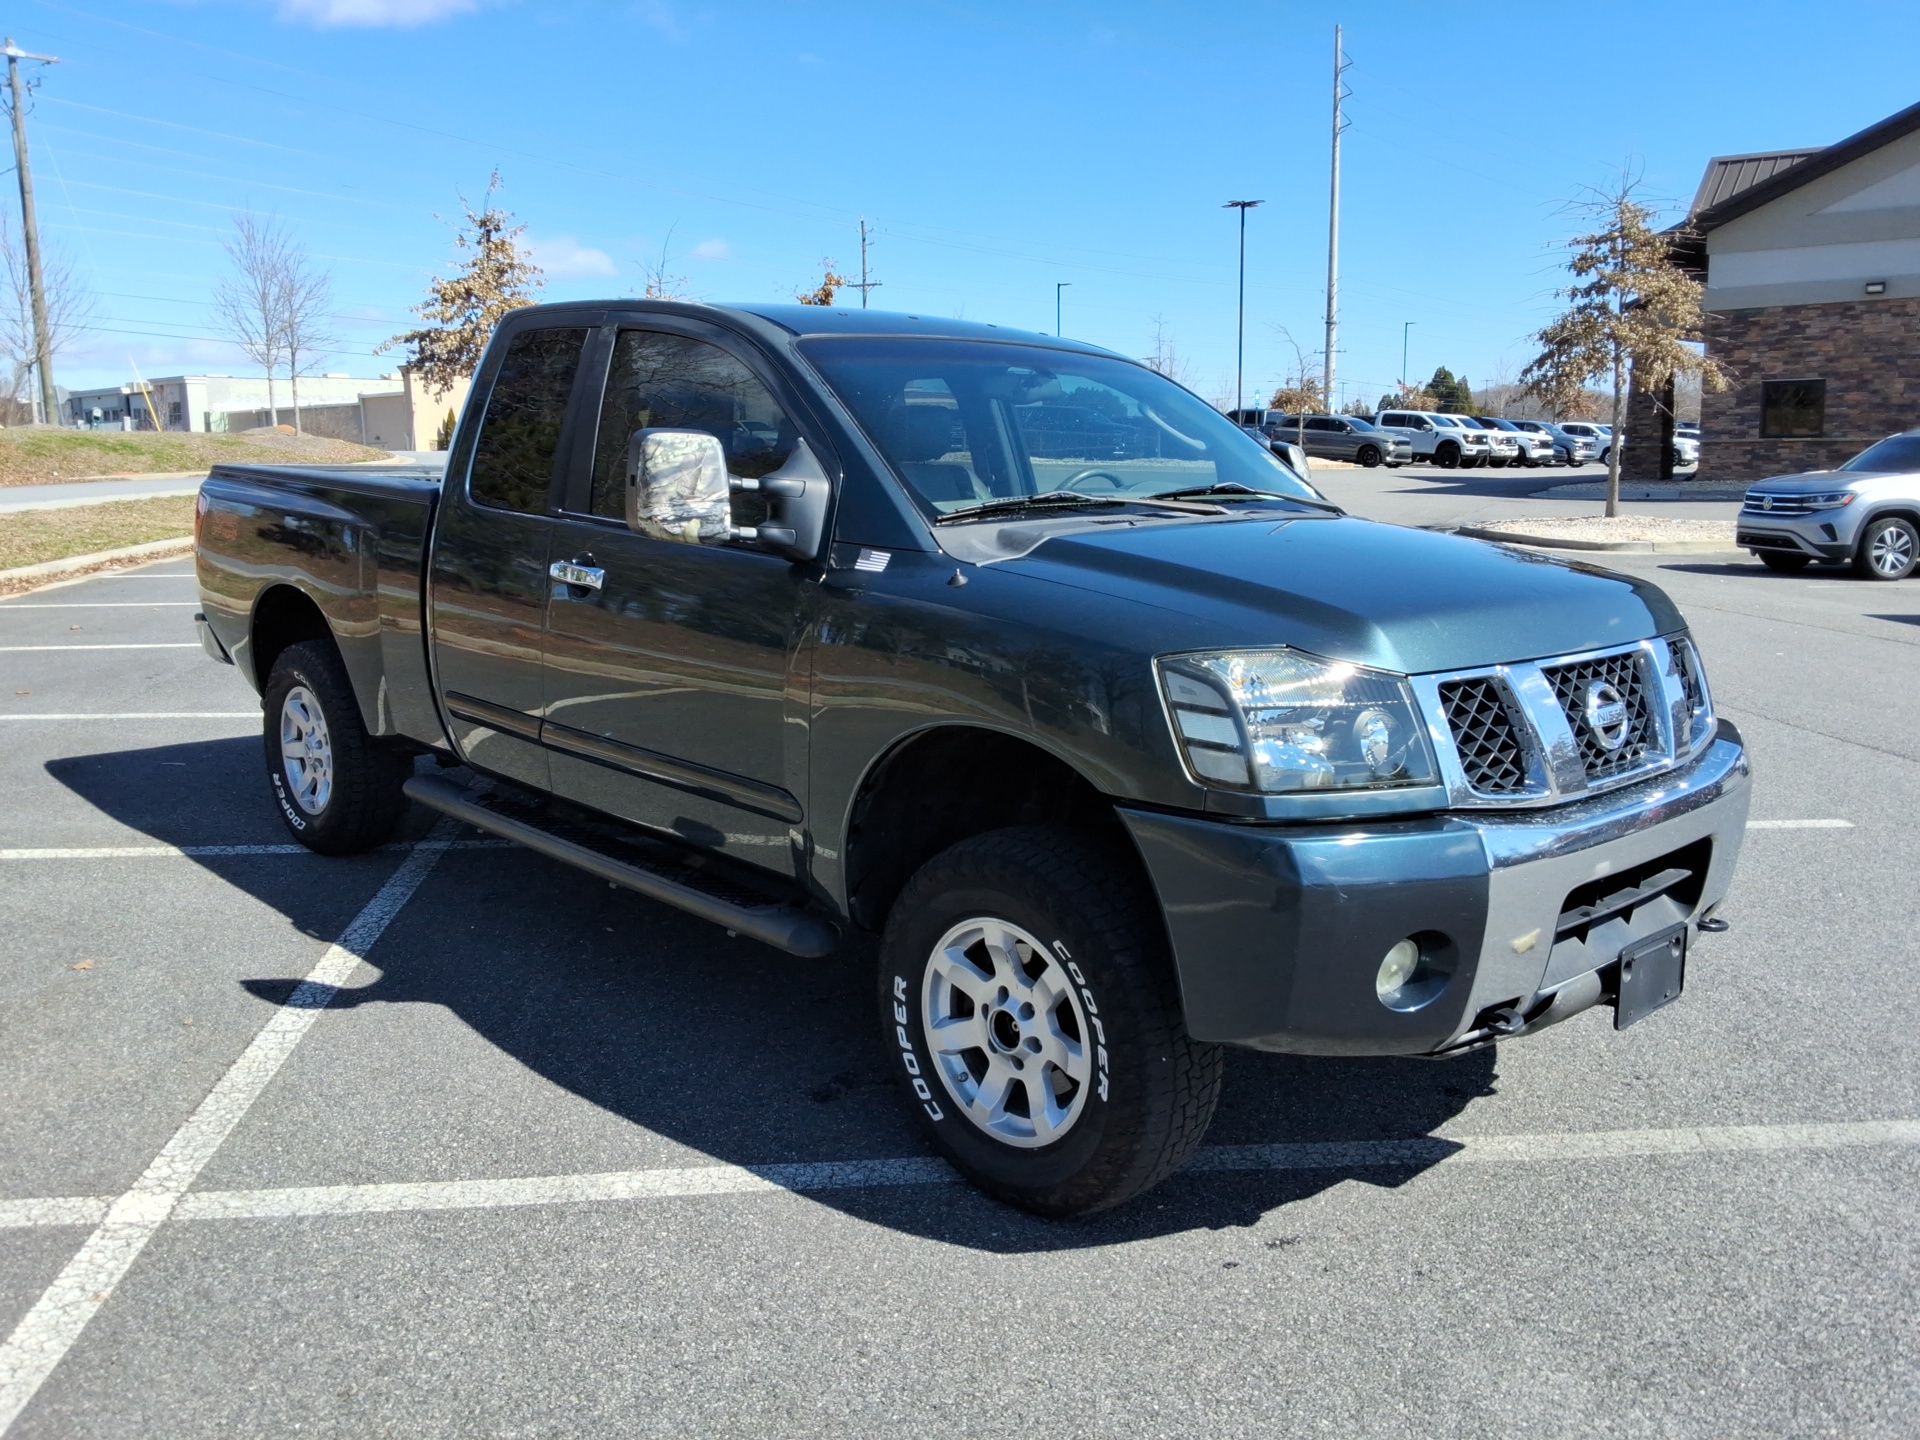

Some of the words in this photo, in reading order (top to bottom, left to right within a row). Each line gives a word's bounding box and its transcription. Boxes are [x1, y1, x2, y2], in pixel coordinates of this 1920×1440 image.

[272, 772, 307, 830] COOPER
[894, 975, 944, 1122] COOPER
[1052, 940, 1109, 1102] COOPER
